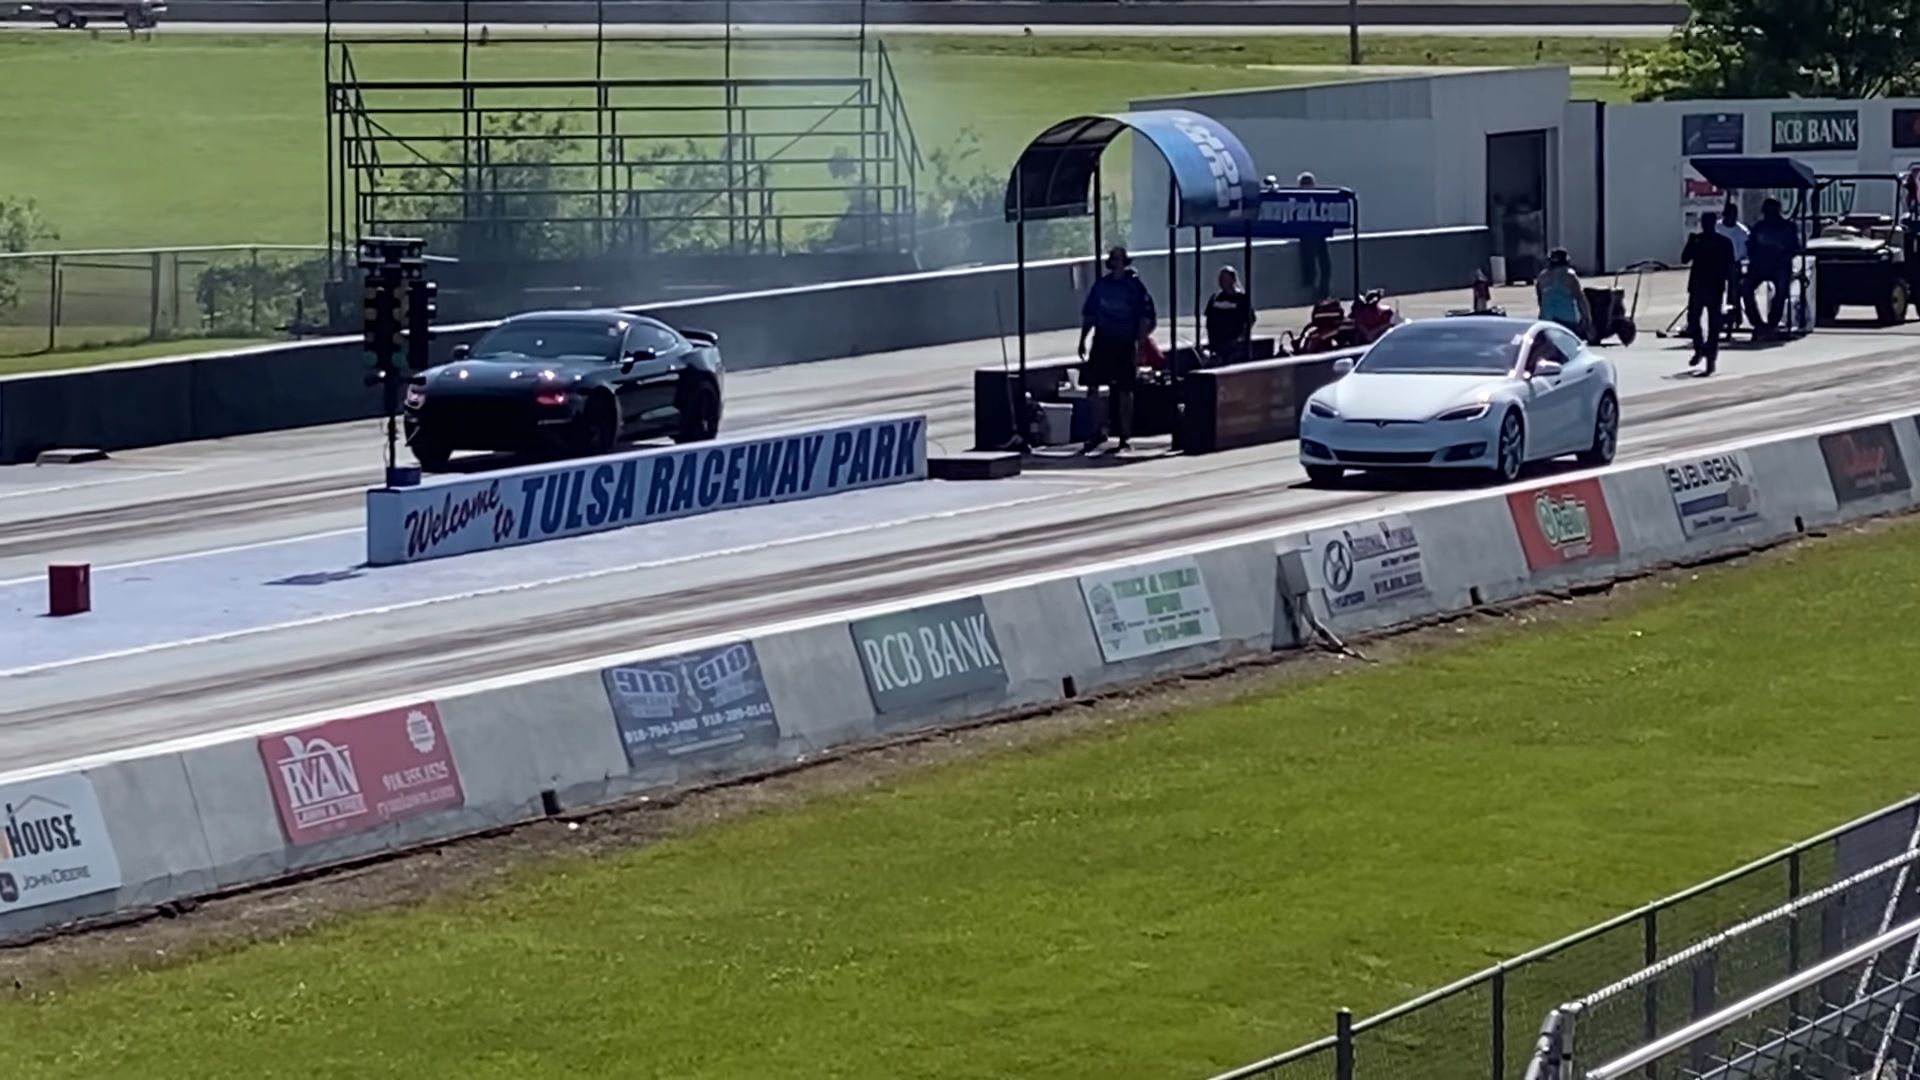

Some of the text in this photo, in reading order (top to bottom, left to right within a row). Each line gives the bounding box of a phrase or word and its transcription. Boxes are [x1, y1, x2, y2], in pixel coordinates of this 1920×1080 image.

[1775, 118, 1857, 145] RCB BANK
[1258, 197, 1349, 224] wayPark.com
[517, 419, 922, 540] TULSA RACEWAY PARK
[1667, 454, 1743, 493] SUBURBAN
[404, 479, 500, 558] Welcome
[492, 503, 515, 543] to
[863, 613, 1000, 693] RCB BANK
[279, 749, 360, 810] RYAN
[23, 864, 91, 892] JOHN DEERE
